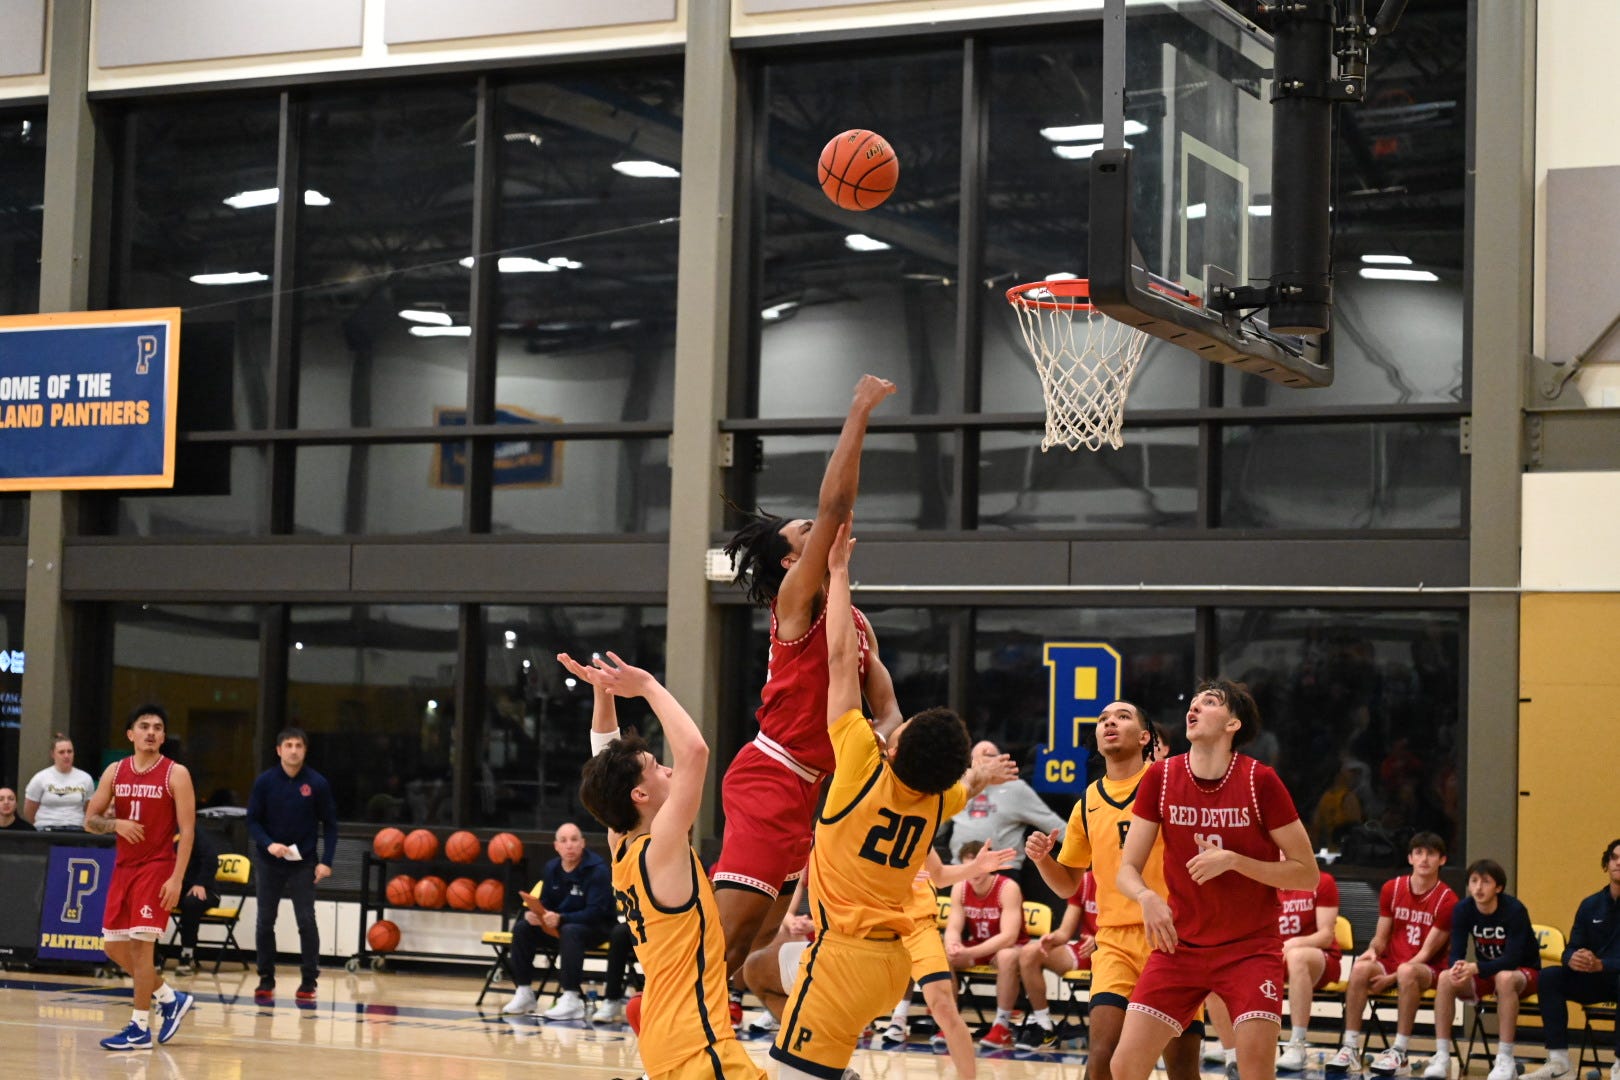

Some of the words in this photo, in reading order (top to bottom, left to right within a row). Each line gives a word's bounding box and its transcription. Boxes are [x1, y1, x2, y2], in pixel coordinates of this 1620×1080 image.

[47, 374, 71, 399] OF
[77, 373, 112, 398] THE
[50, 400, 150, 427] PANTHERS
[1045, 759, 1076, 783] CC
[115, 784, 131, 797] RED
[132, 784, 163, 799] DEVILS
[129, 800, 140, 821] 11
[1169, 805, 1198, 826] RED
[1201, 807, 1251, 828] DEVILS
[858, 807, 927, 869] 20
[61, 858, 100, 923] P
[1283, 899, 1314, 913] DEVILS
[975, 921, 990, 939] 15
[1279, 915, 1301, 935] 23
[1473, 925, 1506, 940] LCC
[793, 1027, 812, 1051] P
